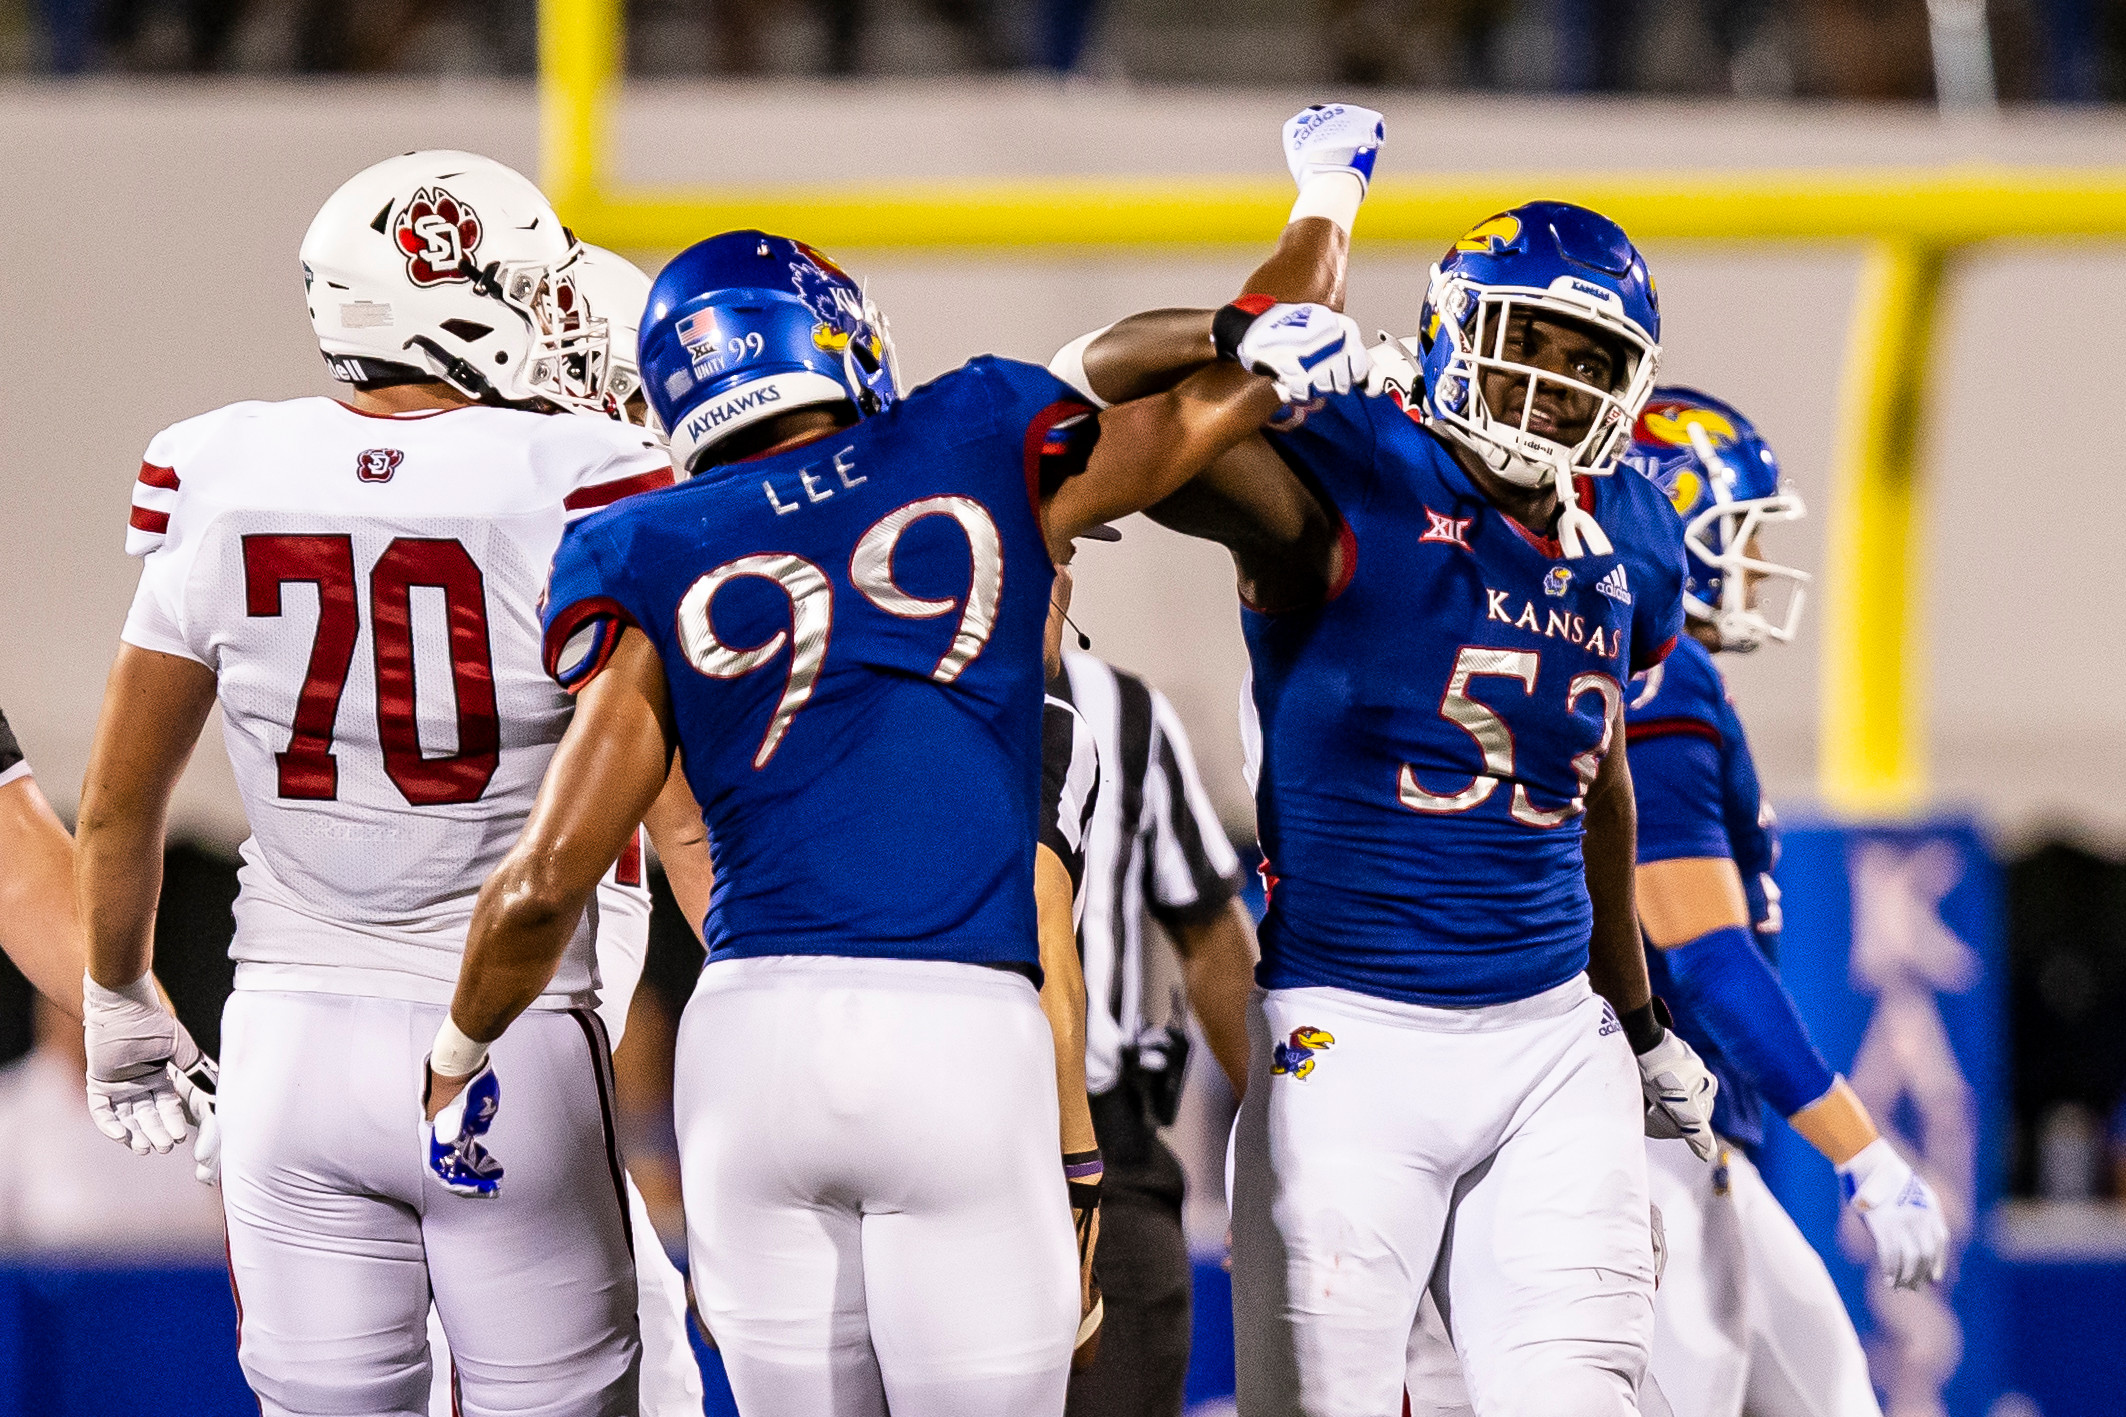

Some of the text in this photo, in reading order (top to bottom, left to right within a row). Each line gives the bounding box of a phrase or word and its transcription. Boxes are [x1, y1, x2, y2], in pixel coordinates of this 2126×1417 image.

[693, 356, 725, 380] UNITY
[728, 332, 764, 362] 99
[687, 384, 781, 444] JAYHAWKS
[762, 445, 868, 515] LEE
[674, 493, 1004, 771] 99
[1486, 588, 1622, 660] KANSAS
[241, 532, 500, 806] 70
[1397, 644, 1622, 828] 53
